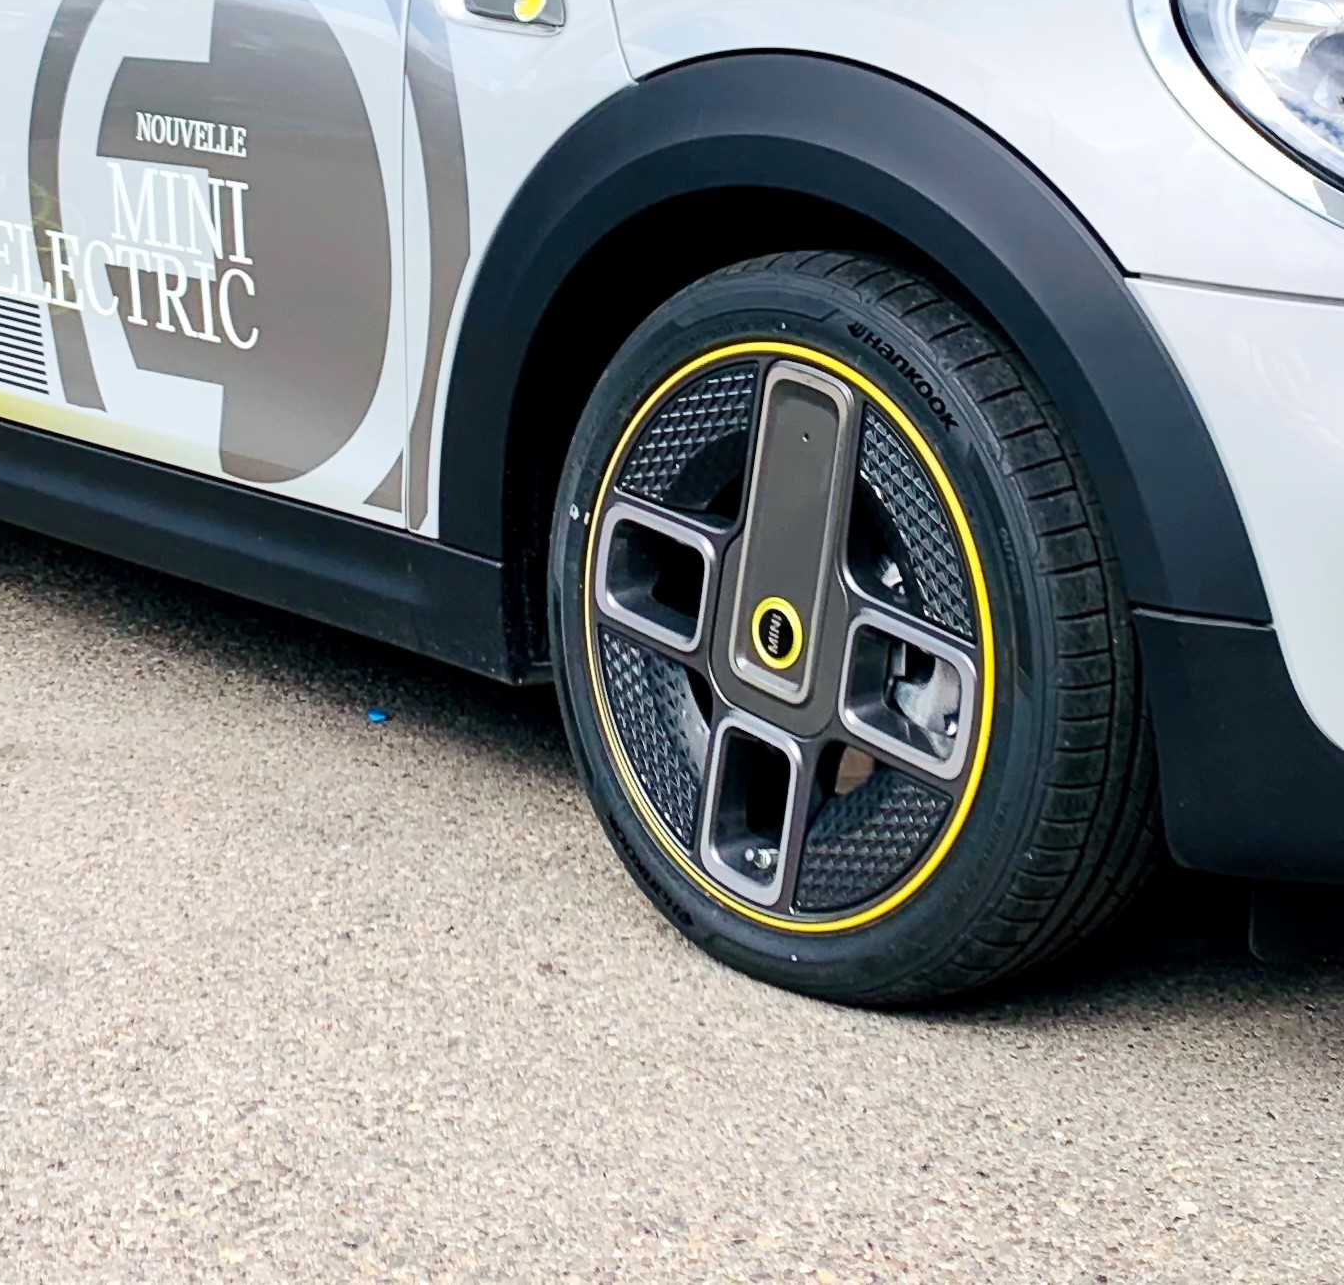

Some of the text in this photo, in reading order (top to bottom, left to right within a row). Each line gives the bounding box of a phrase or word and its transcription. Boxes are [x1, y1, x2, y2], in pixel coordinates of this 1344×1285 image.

[135, 111, 247, 157] NOUVELLE
[107, 161, 253, 265] MINI
[767, 613, 782, 655] MINI
